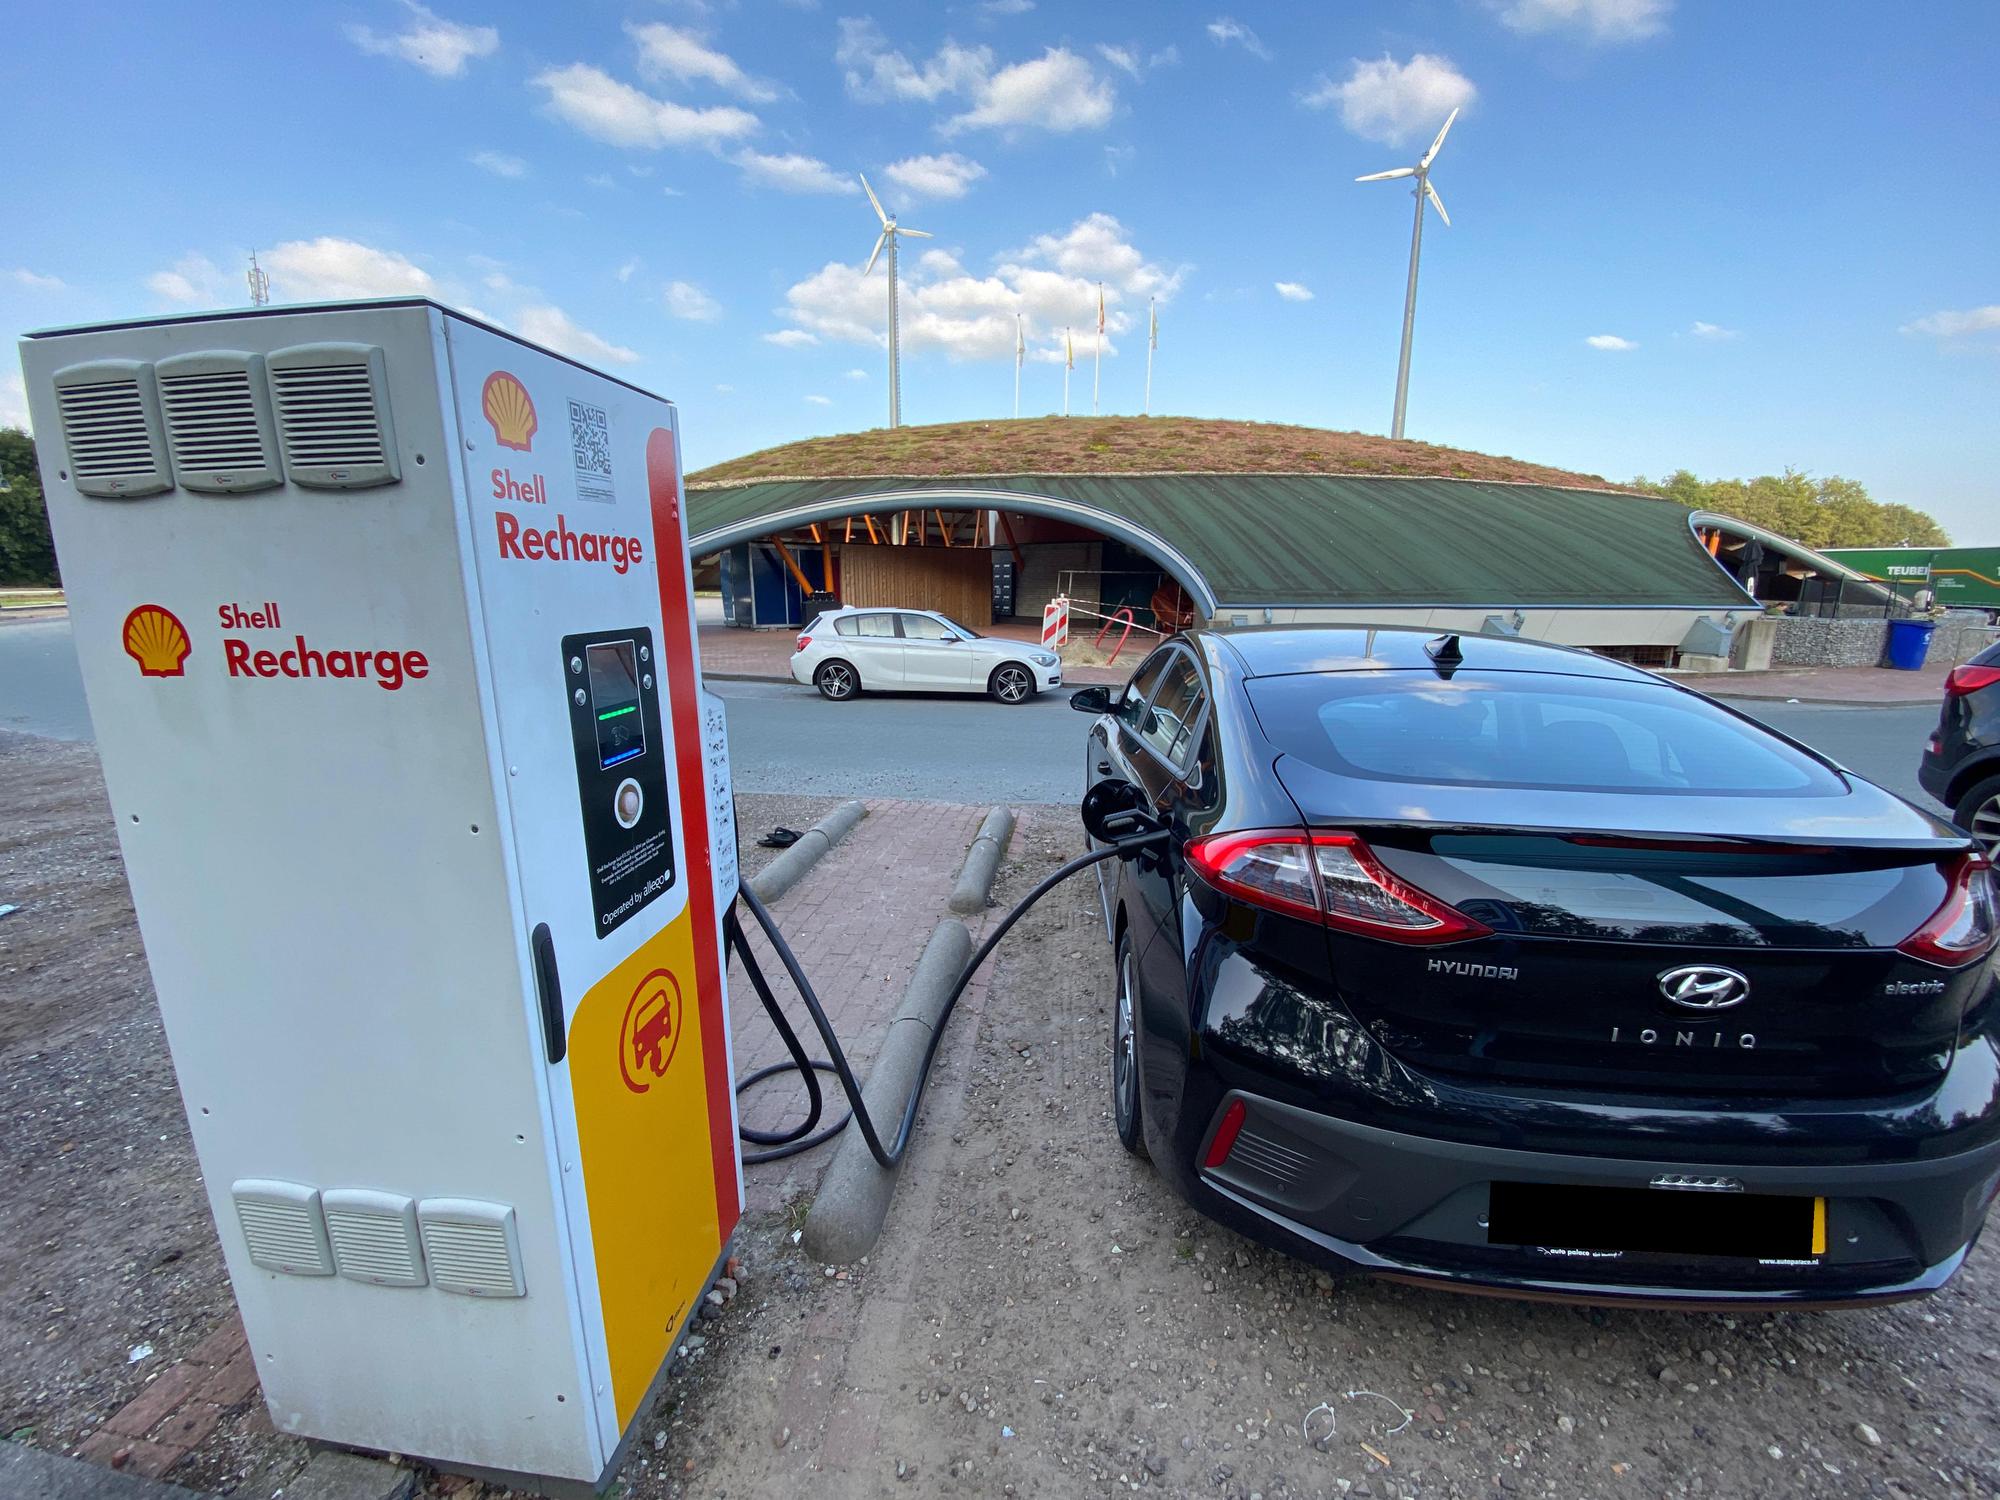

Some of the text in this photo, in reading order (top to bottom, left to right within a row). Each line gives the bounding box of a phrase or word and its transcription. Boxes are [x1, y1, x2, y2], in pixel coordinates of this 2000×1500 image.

[491, 468, 546, 504] Shell
[495, 511, 643, 574] Recharge
[218, 602, 281, 629] Shell
[223, 635, 429, 691] Recharge
[602, 875, 665, 925] Operated by allego
[1427, 959, 1519, 980] HYUNDAI
[1885, 979, 1945, 995] electric
[1610, 1027, 1756, 1049] IONIQ
